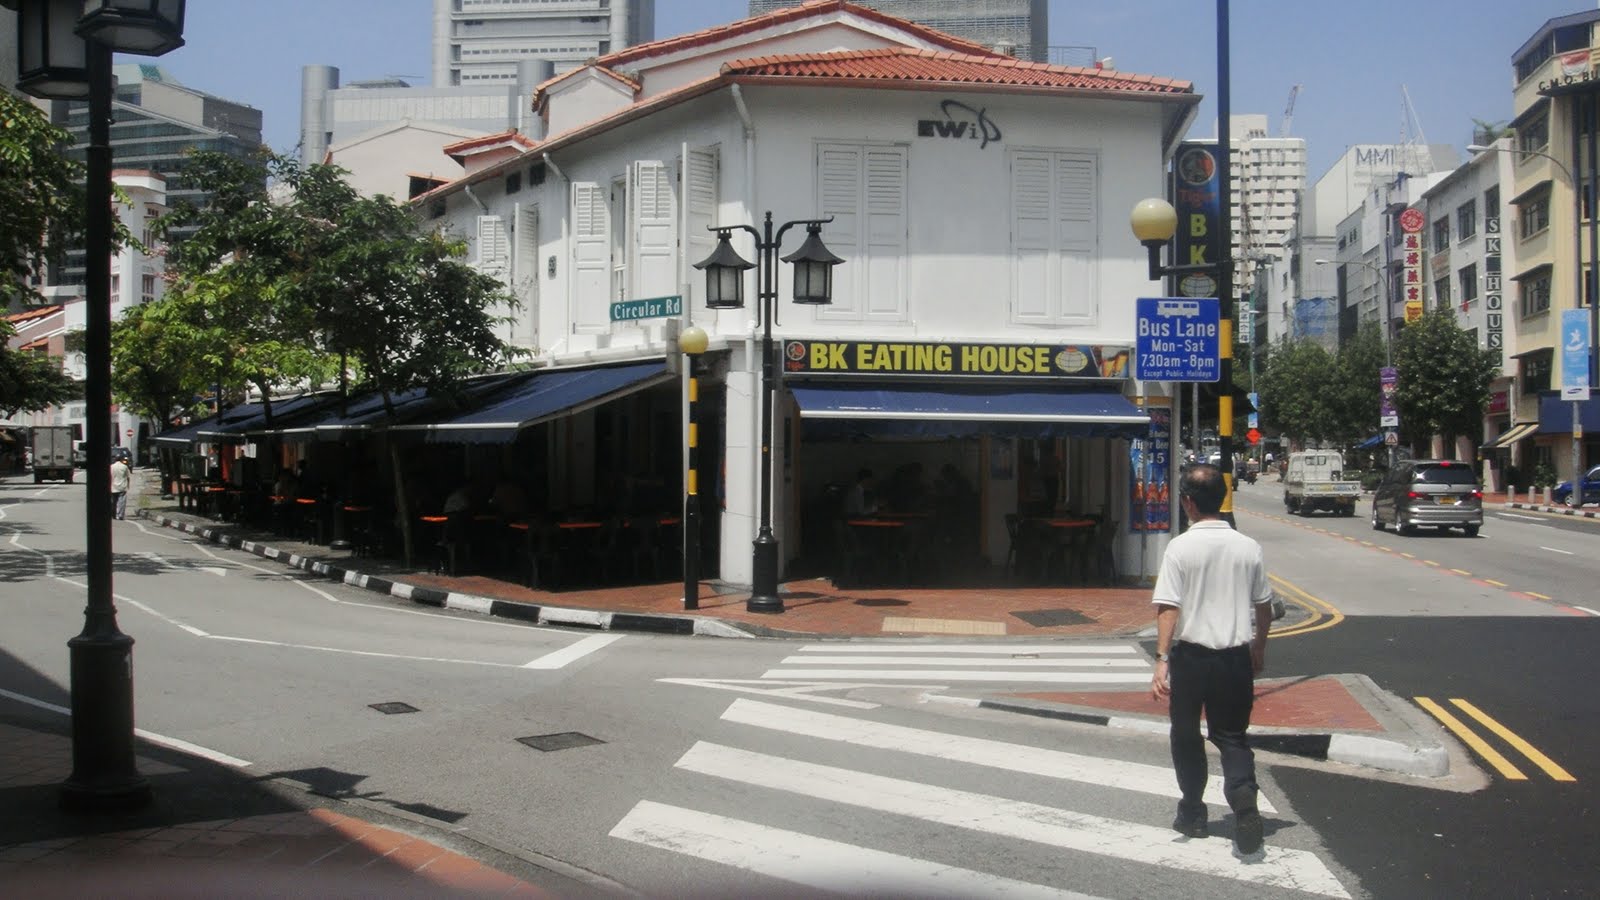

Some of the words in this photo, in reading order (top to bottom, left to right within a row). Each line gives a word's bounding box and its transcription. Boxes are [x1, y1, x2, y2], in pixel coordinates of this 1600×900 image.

[614, 301, 661, 319] Circular
[666, 298, 680, 314] Rd
[1139, 318, 1170, 337] Bus
[1176, 318, 1216, 337] Lane
[810, 343, 849, 370] BK
[857, 343, 952, 371] EATING
[961, 345, 1050, 373] HOUSE
[1165, 370, 1184, 378] Public
